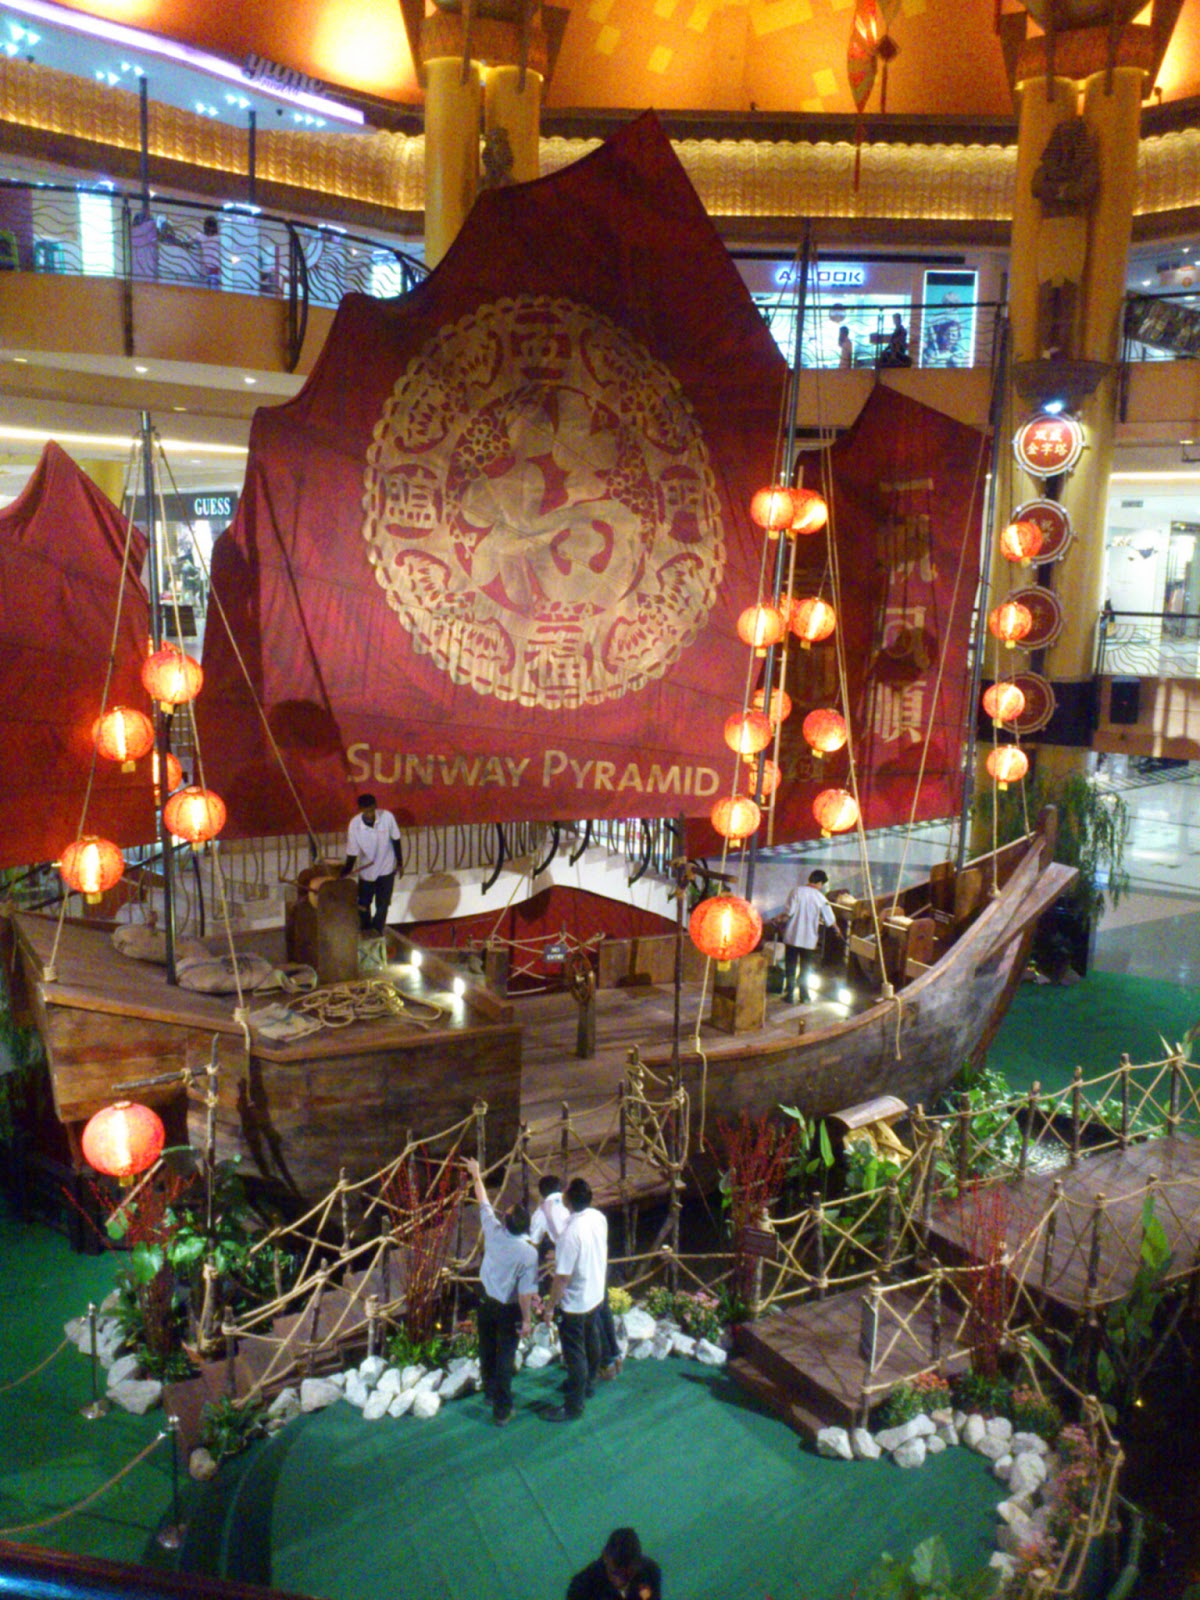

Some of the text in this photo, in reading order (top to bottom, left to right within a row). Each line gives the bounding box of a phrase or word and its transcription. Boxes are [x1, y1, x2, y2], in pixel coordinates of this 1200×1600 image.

[194, 497, 231, 515] GUESS
[346, 743, 719, 796] SUNWAY PYRAMID
